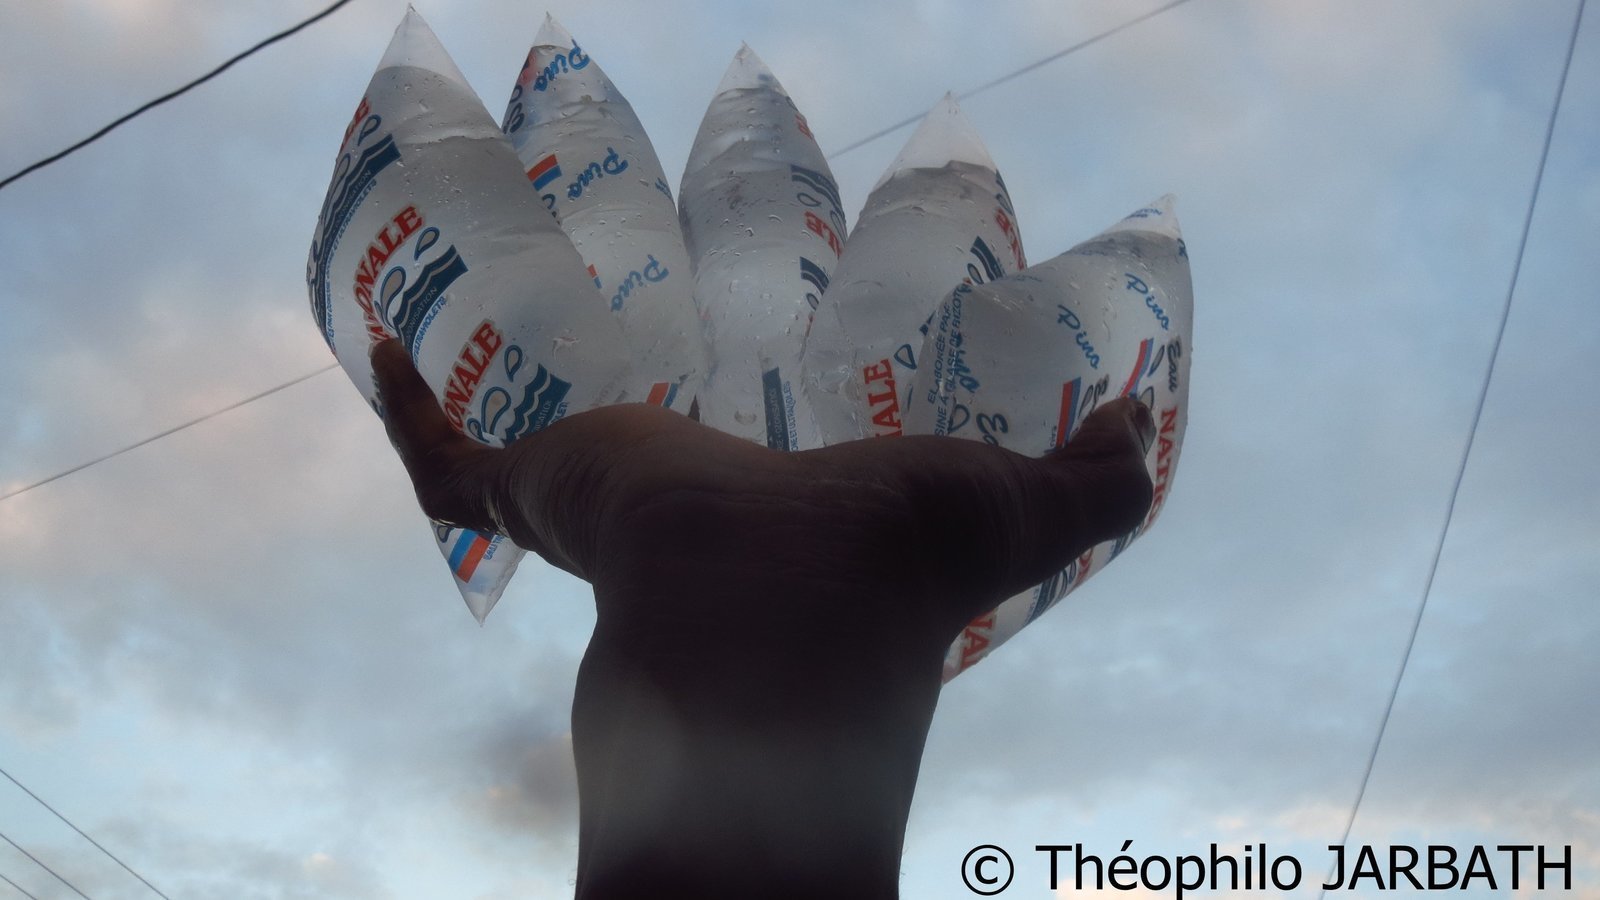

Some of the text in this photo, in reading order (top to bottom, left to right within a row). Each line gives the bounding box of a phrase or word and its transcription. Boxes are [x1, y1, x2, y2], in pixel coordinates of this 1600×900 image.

[533, 39, 591, 92] Pino
[567, 147, 629, 201] Pino
[611, 254, 669, 312] Pino
[1125, 273, 1169, 331] Pino
[1057, 304, 1100, 370] Pino
